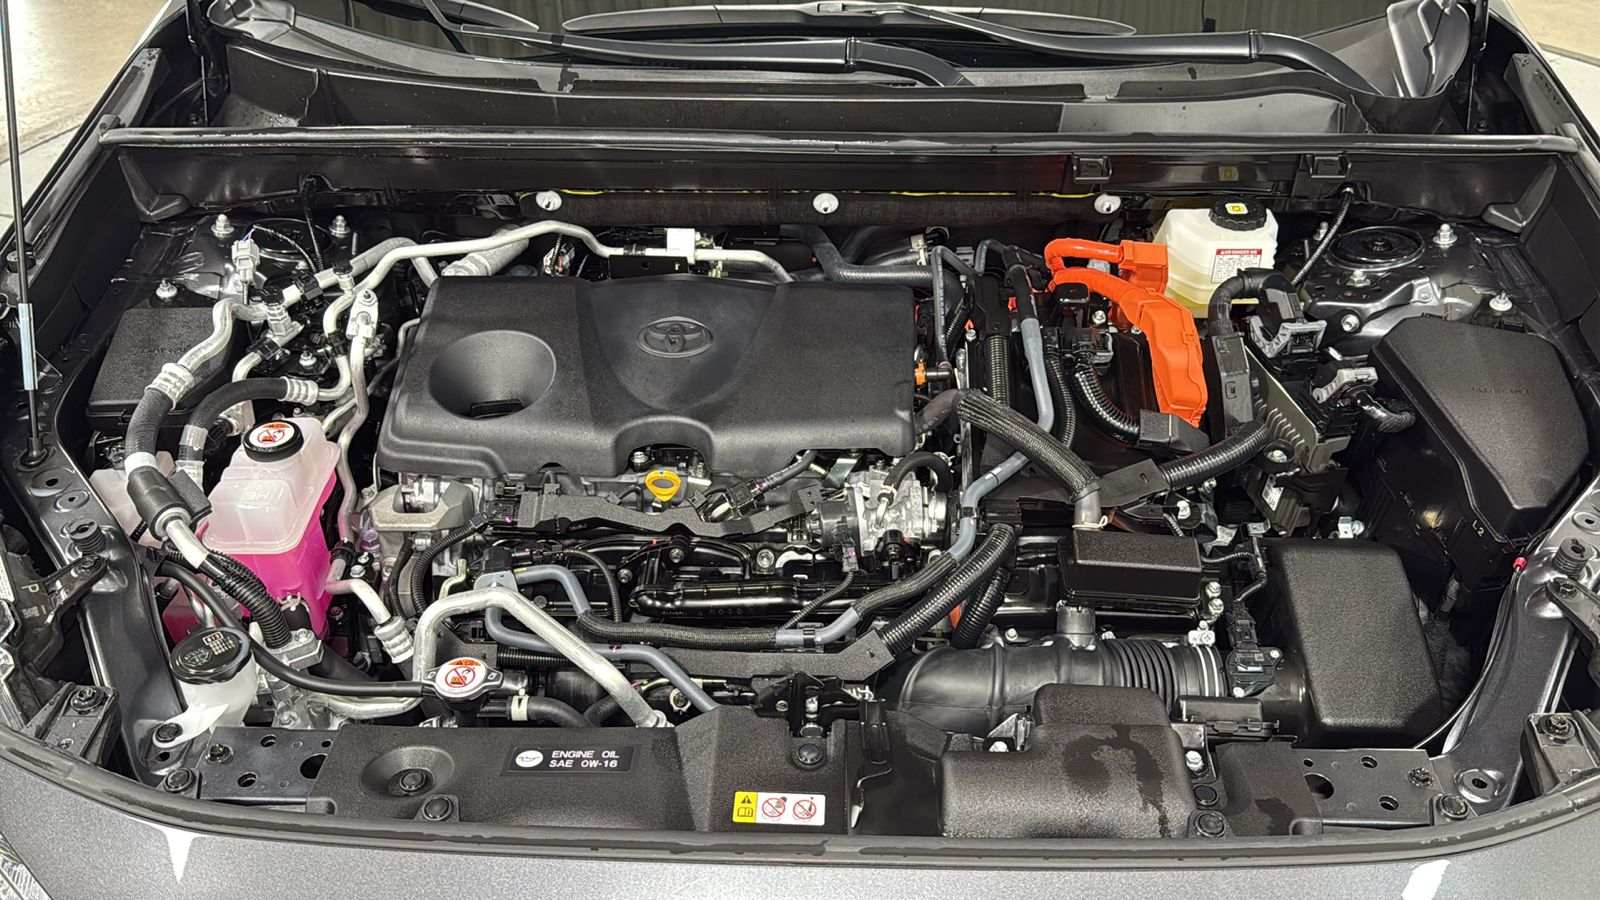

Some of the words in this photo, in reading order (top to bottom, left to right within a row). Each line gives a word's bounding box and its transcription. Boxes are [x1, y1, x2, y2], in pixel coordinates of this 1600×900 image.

[551, 750, 595, 758] ENGINE
[601, 750, 620, 758] OIL
[549, 759, 574, 768] SAE
[581, 759, 618, 768] 0W-16
